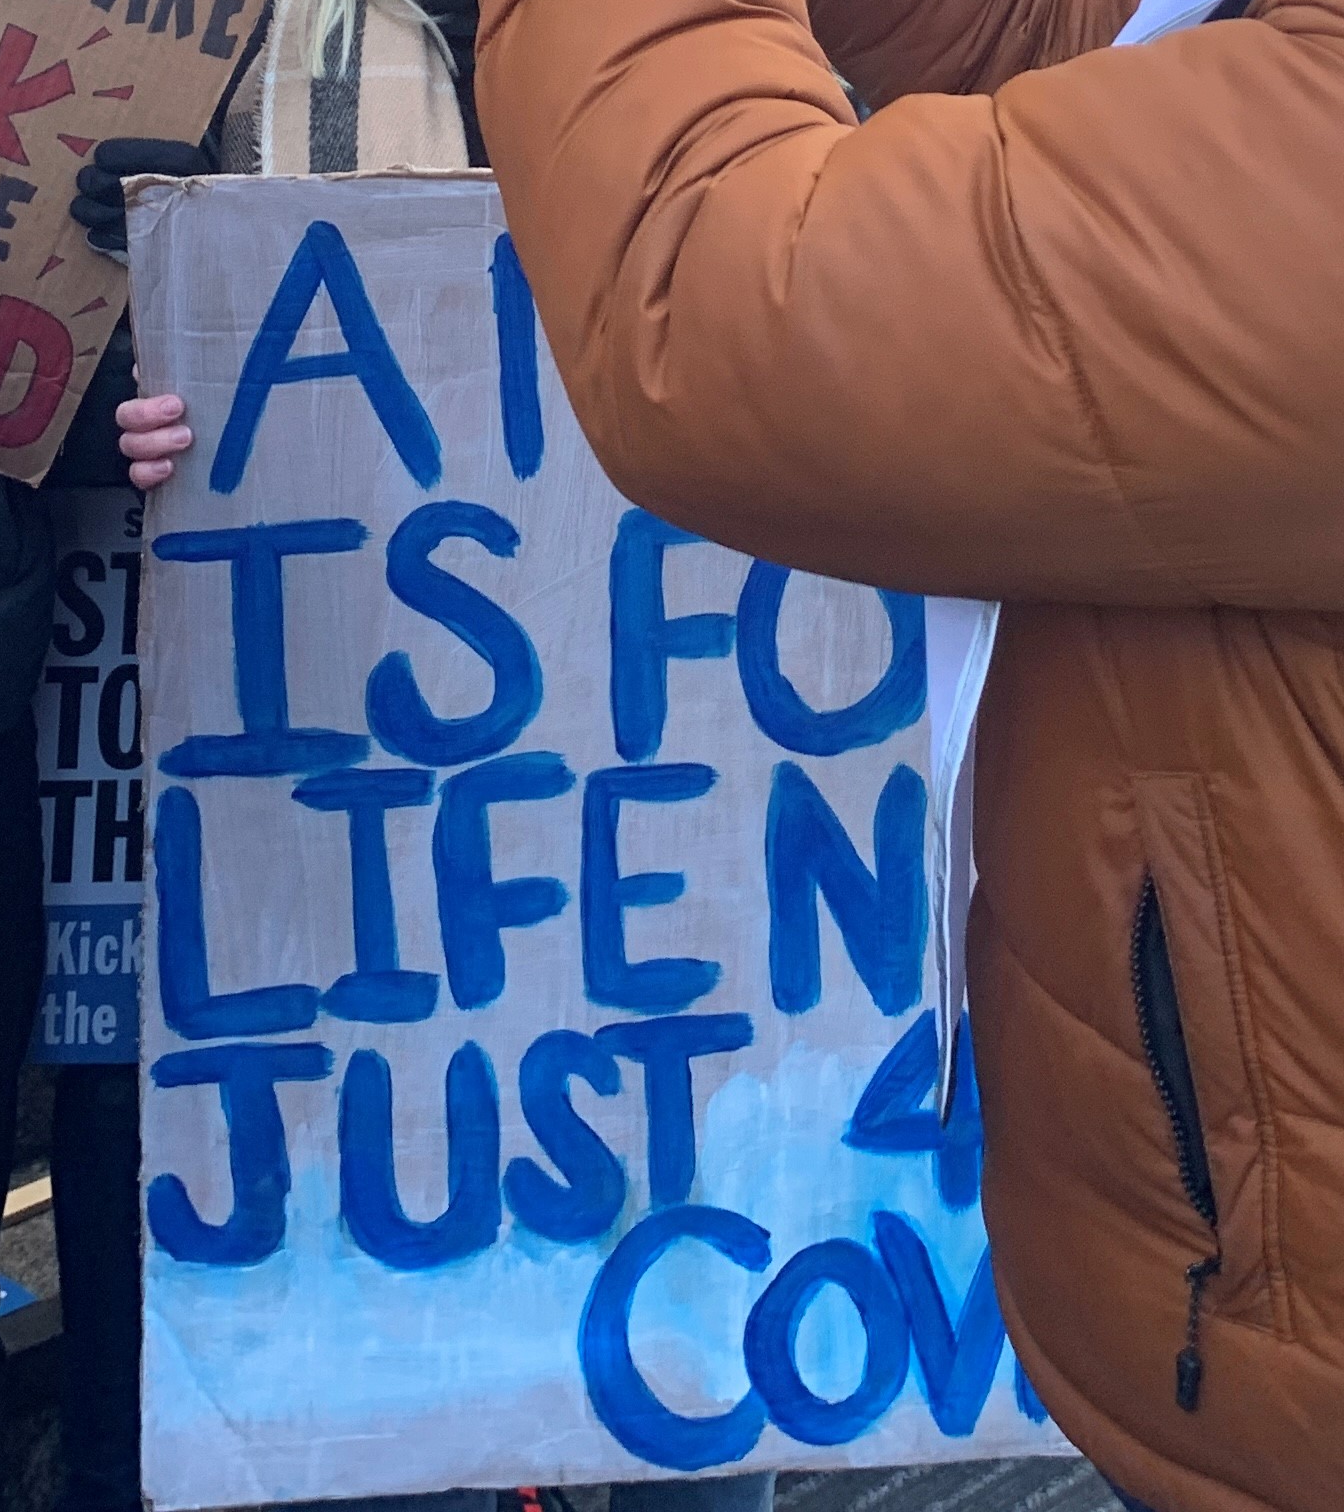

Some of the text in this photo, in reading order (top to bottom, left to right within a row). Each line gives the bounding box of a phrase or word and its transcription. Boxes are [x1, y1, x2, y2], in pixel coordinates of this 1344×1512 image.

[210, 218, 444, 494] A
[152, 500, 545, 778] IS
[42, 992, 117, 1046] the
[154, 752, 724, 1041] LIFE
[146, 1012, 756, 1271] JUST
[576, 1204, 1050, 1473] COV
